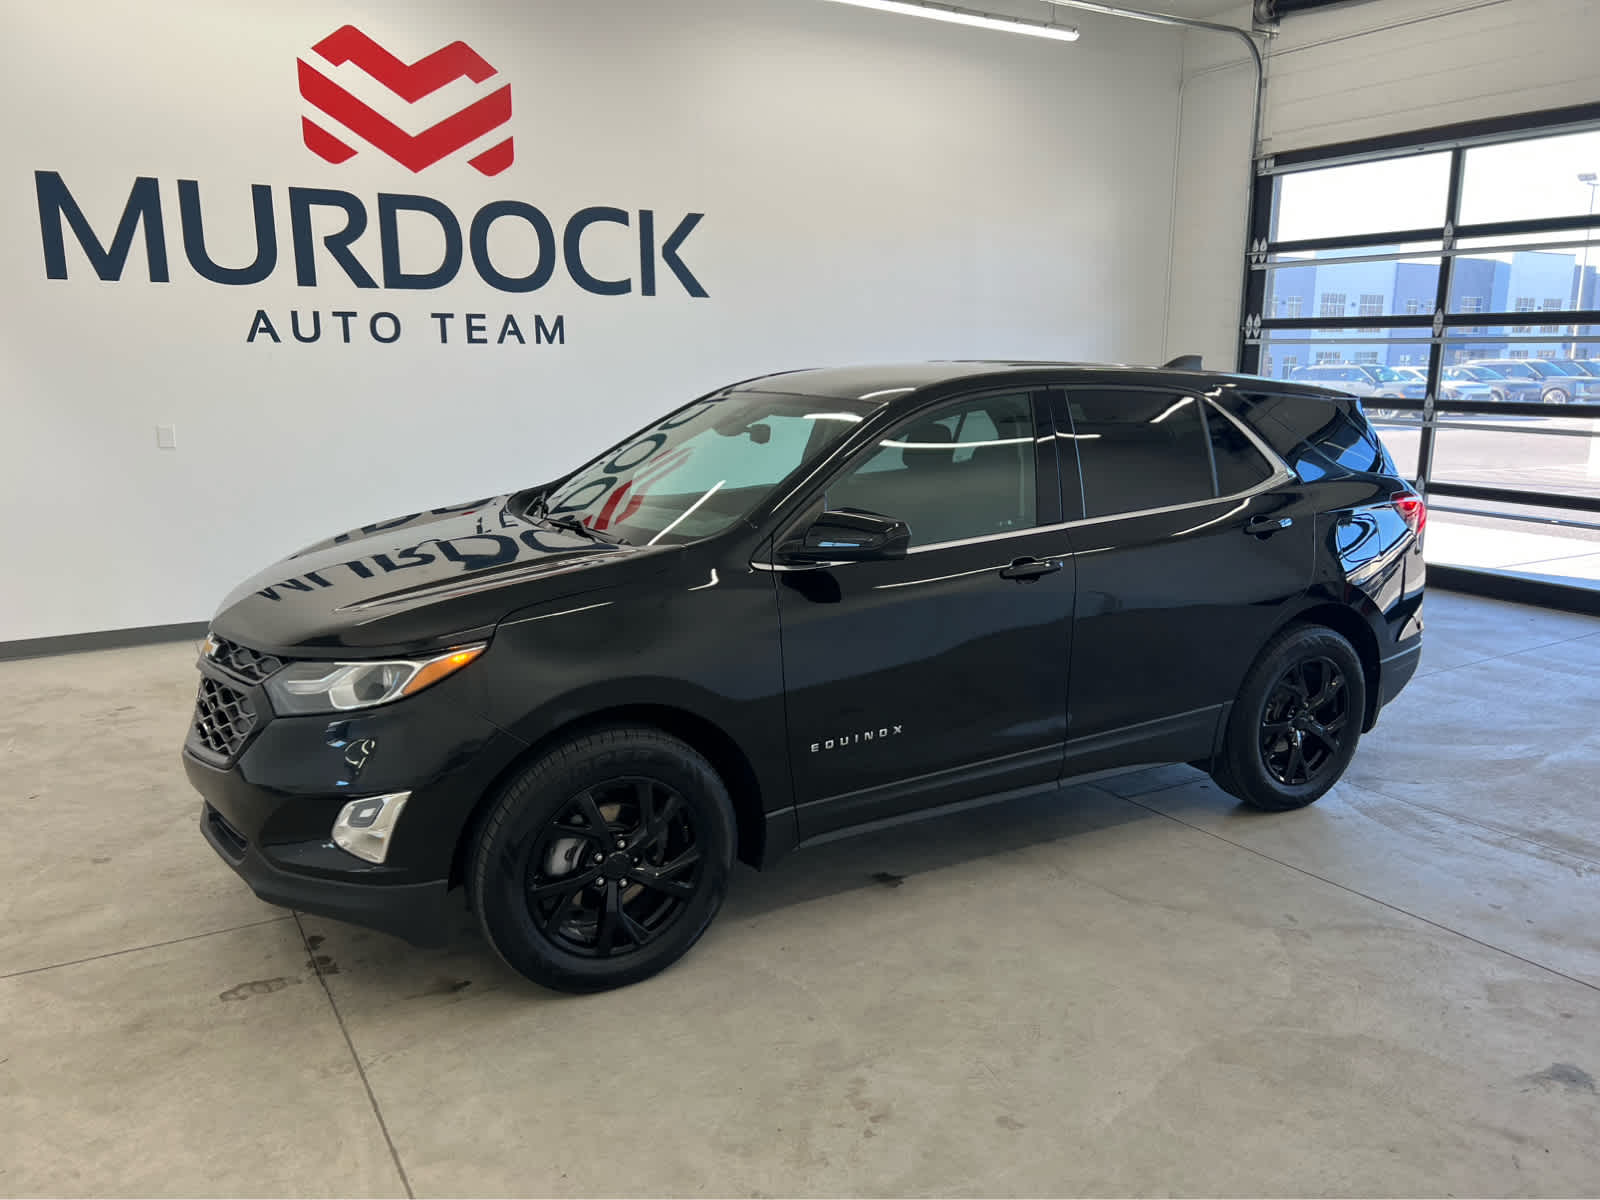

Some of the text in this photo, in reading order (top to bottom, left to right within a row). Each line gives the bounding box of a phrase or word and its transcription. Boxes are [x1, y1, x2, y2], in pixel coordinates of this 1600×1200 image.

[34, 170, 710, 298] MURDOCK
[246, 309, 566, 345] AUTO TEAM
[810, 724, 903, 753] EQUINOX
